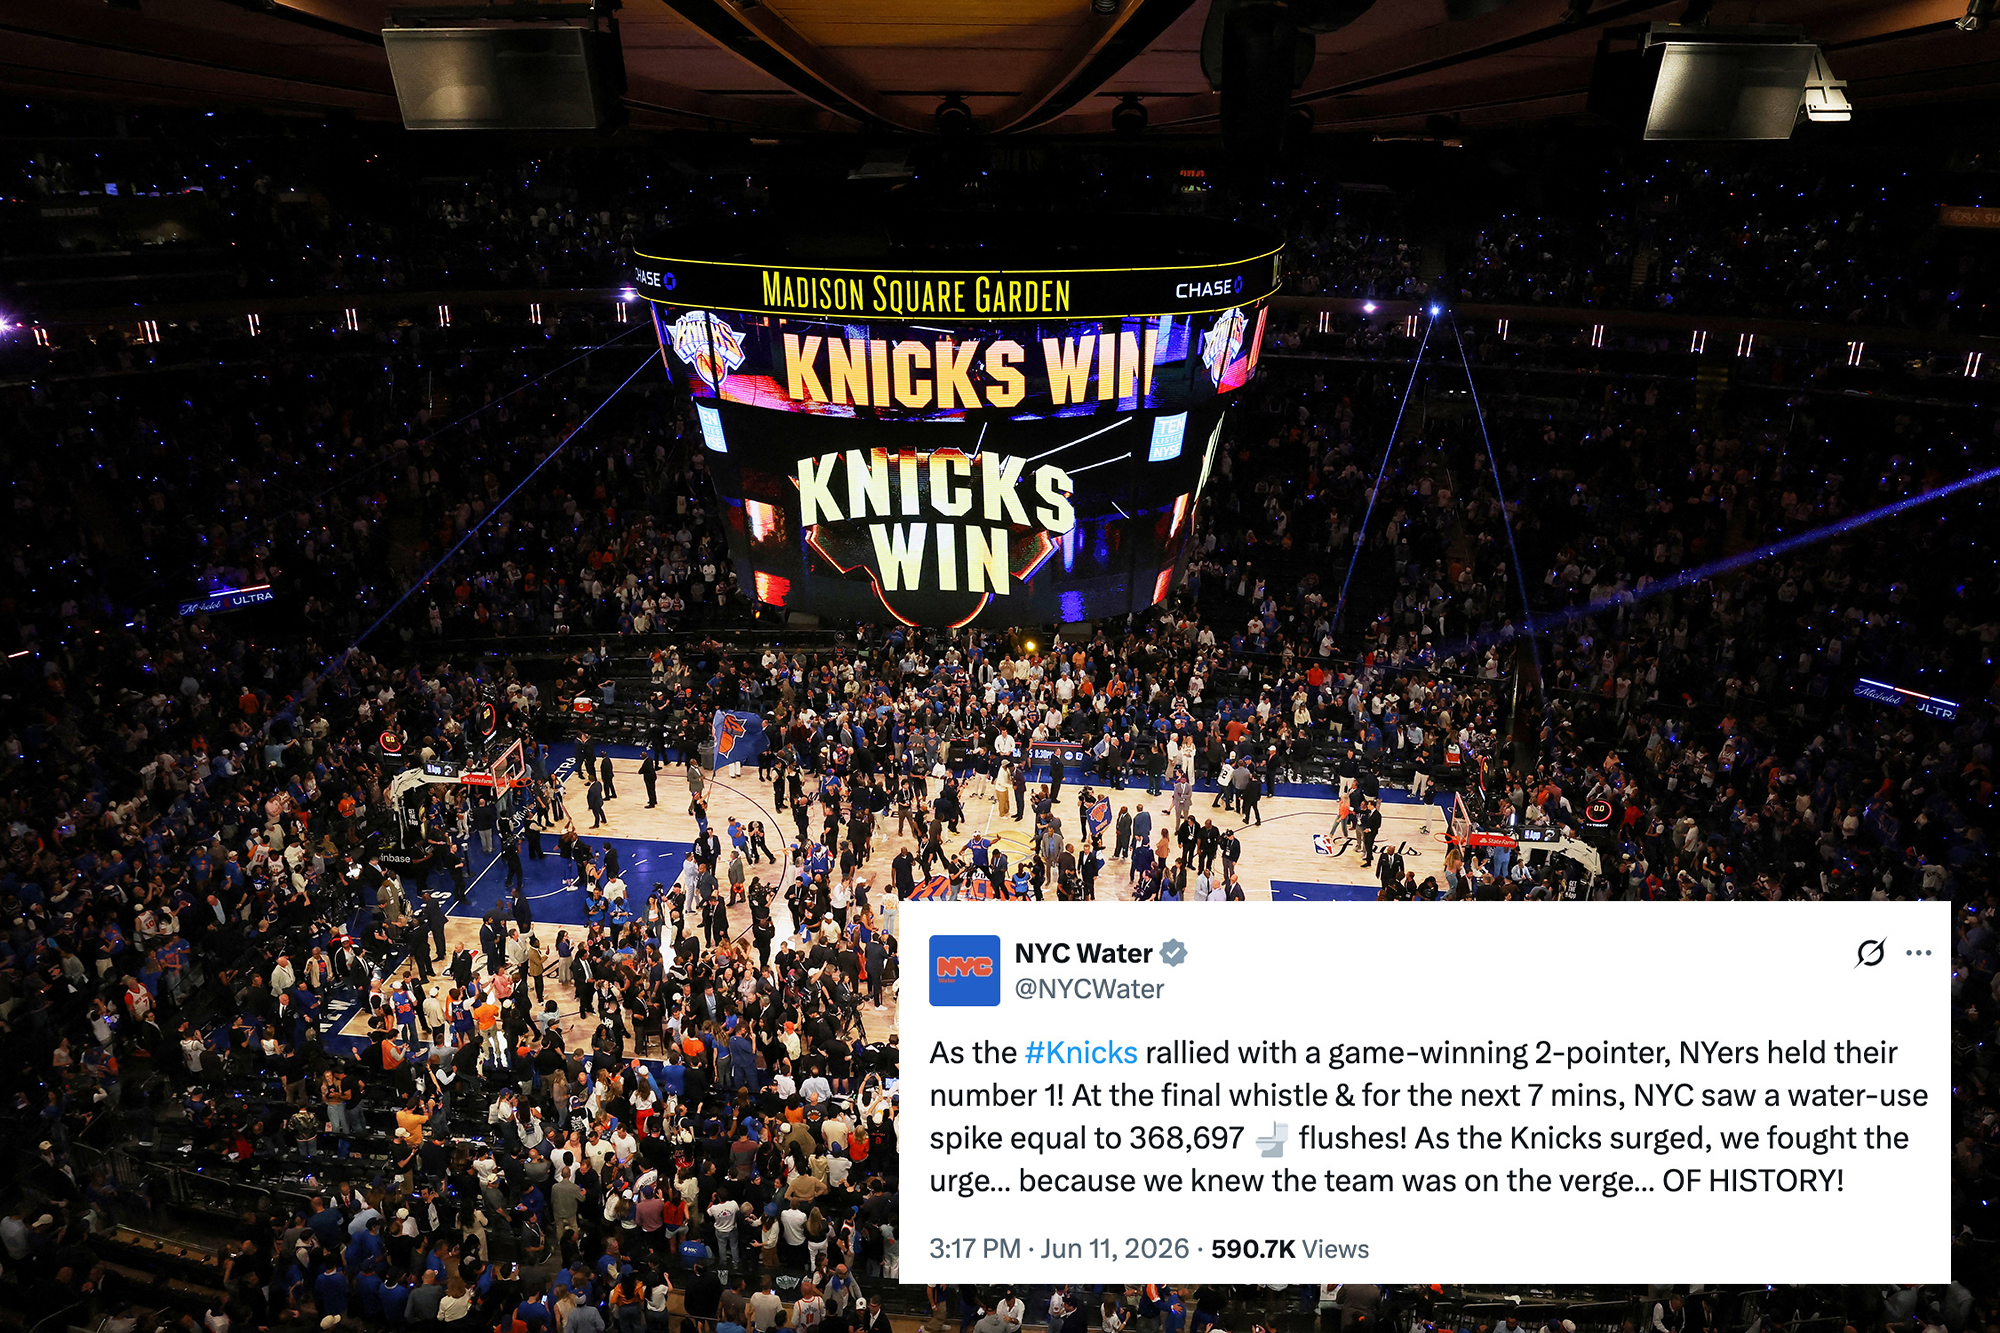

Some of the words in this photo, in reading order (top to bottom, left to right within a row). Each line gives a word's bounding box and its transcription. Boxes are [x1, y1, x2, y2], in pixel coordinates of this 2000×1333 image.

[763, 271, 864, 311] MADISON
[873, 275, 968, 314] SQUARE
[975, 276, 1070, 313] GARDEN
[1176, 279, 1232, 299] CHASE
[783, 333, 1025, 408] KNICKS
[1042, 329, 1157, 404] WIN
[1153, 443, 1181, 458] NYSE
[797, 447, 1075, 535] KNICKS
[869, 522, 1010, 596] WIN
[233, 592, 273, 605] ULTRA
[1854, 685, 1901, 704] Michelob
